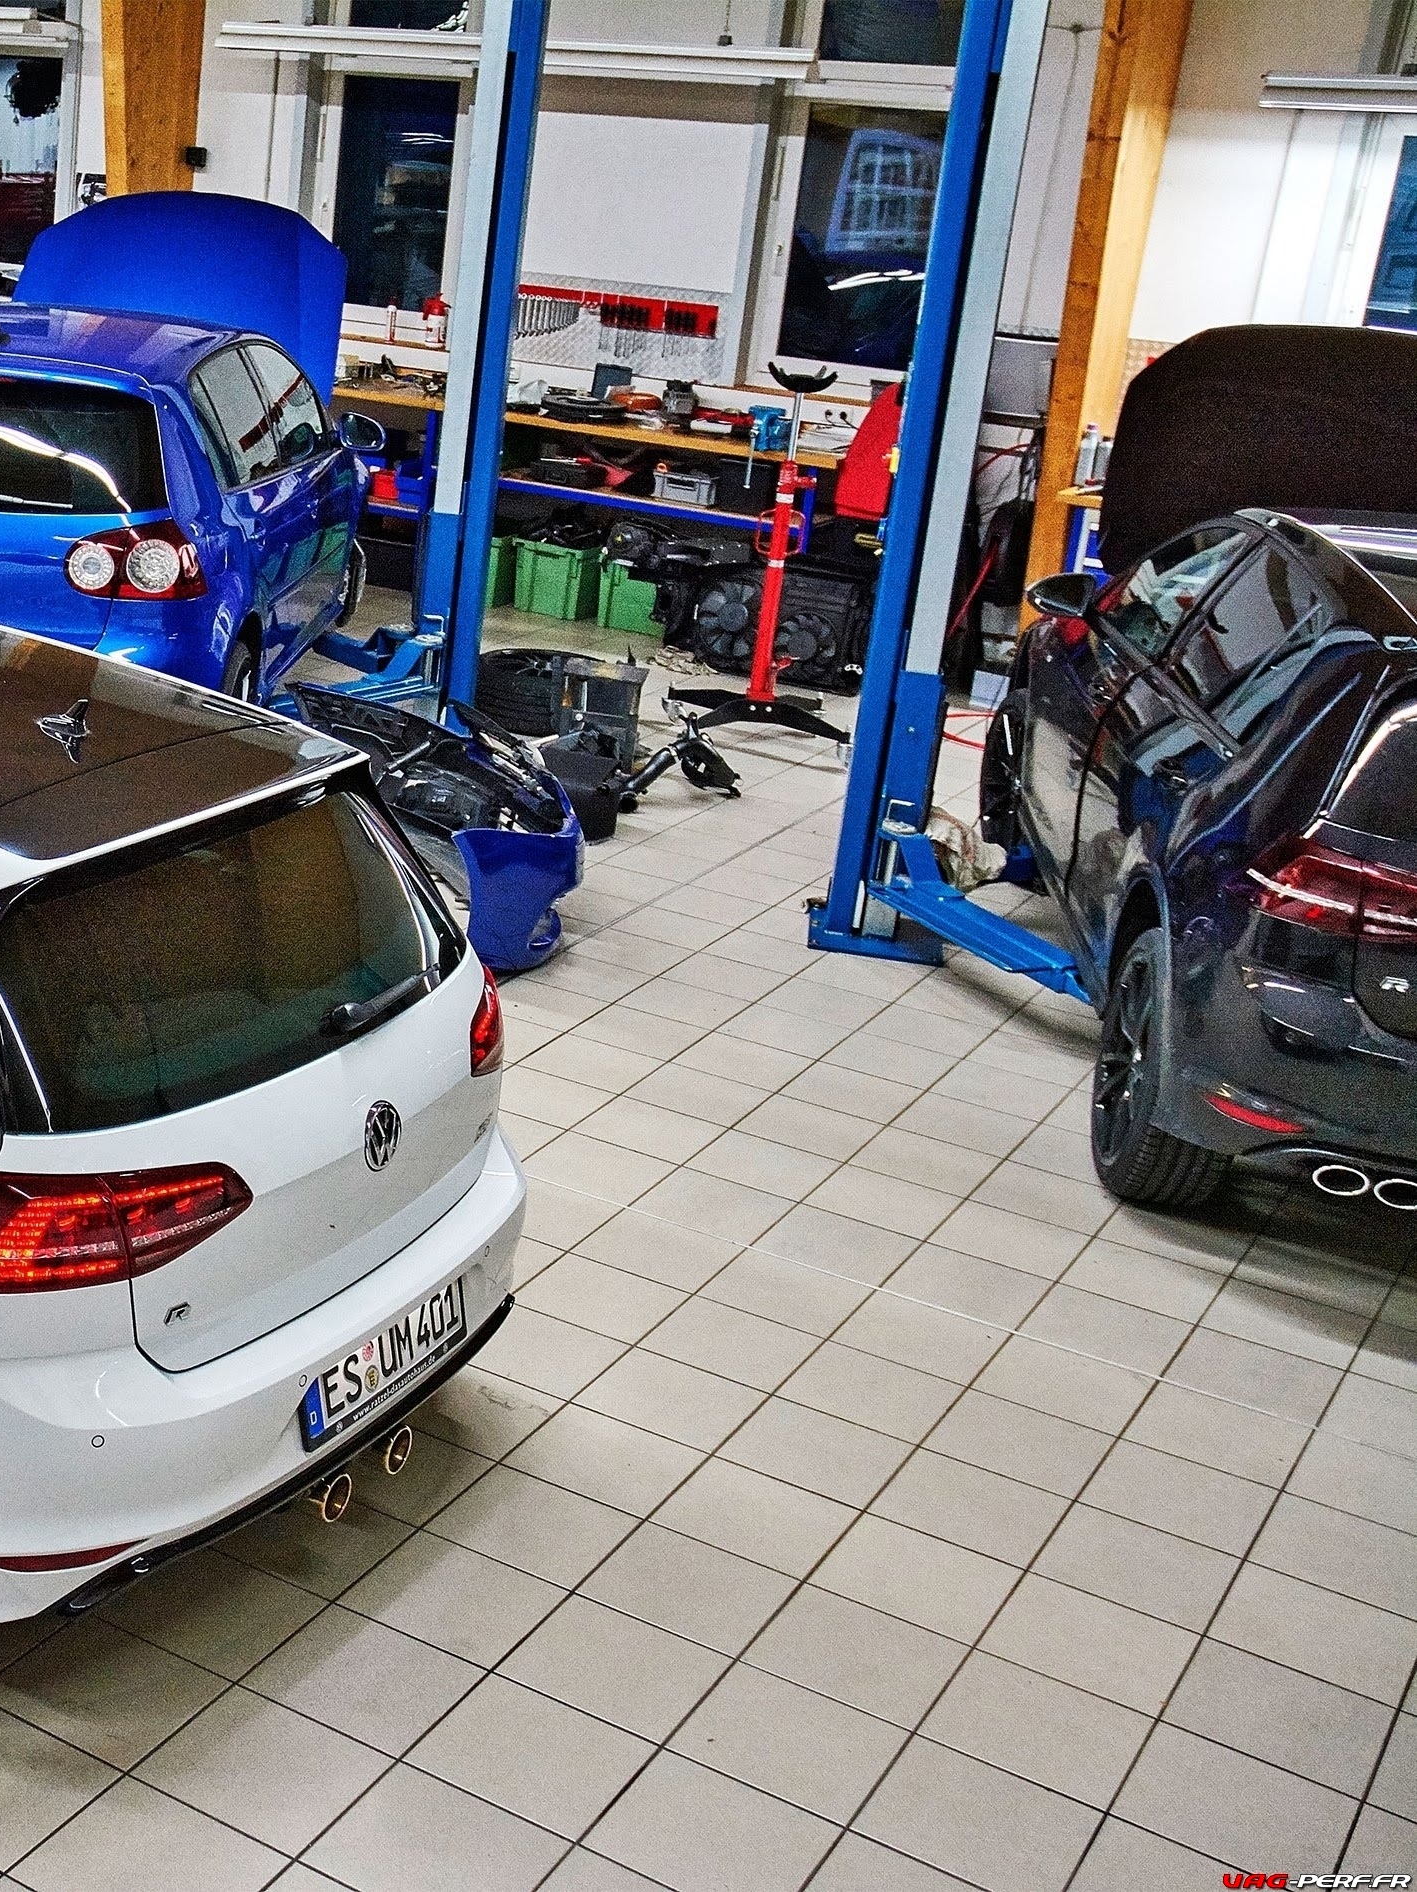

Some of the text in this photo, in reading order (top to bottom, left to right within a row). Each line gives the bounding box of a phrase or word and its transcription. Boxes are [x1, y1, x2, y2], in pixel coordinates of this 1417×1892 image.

[365, 1100, 402, 1171] VW
[163, 1301, 191, 1326] R
[322, 1283, 459, 1419] ES UM 401
[352, 1355, 437, 1422] www.ratzel-dasautohaus.de
